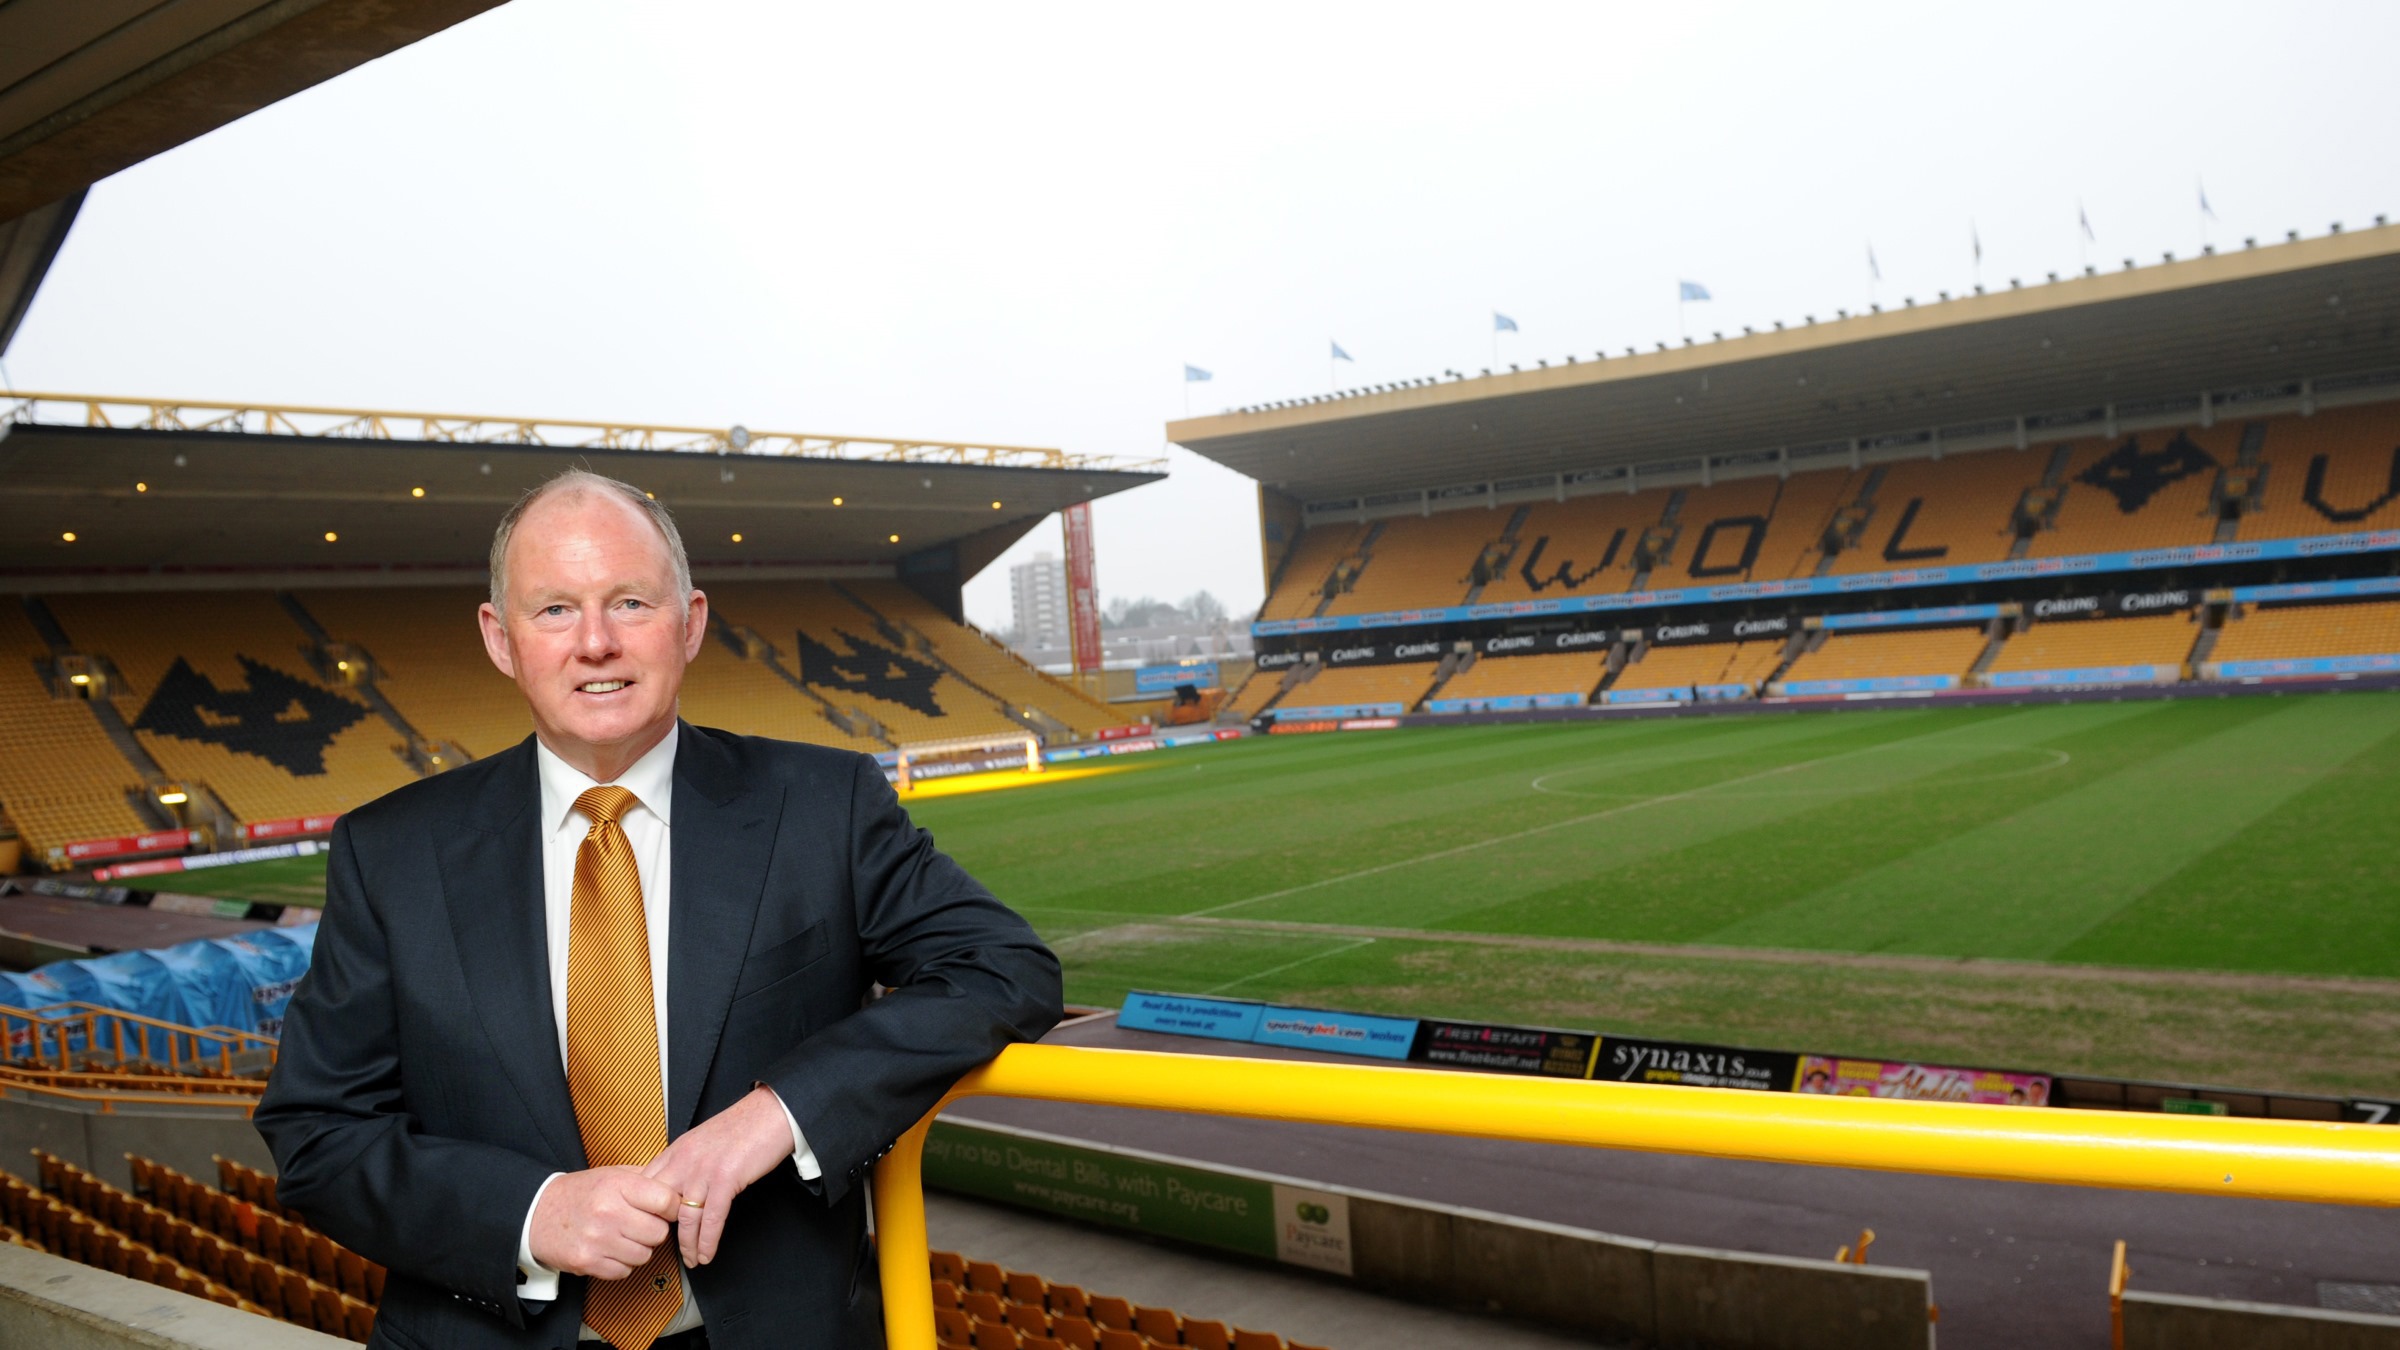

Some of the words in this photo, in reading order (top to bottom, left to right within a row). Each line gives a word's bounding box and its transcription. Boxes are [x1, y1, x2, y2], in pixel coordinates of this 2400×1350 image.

[1006, 1146, 1067, 1180] Dental
[1115, 1171, 1159, 1200] with
[1166, 1177, 1249, 1217] Paycare
